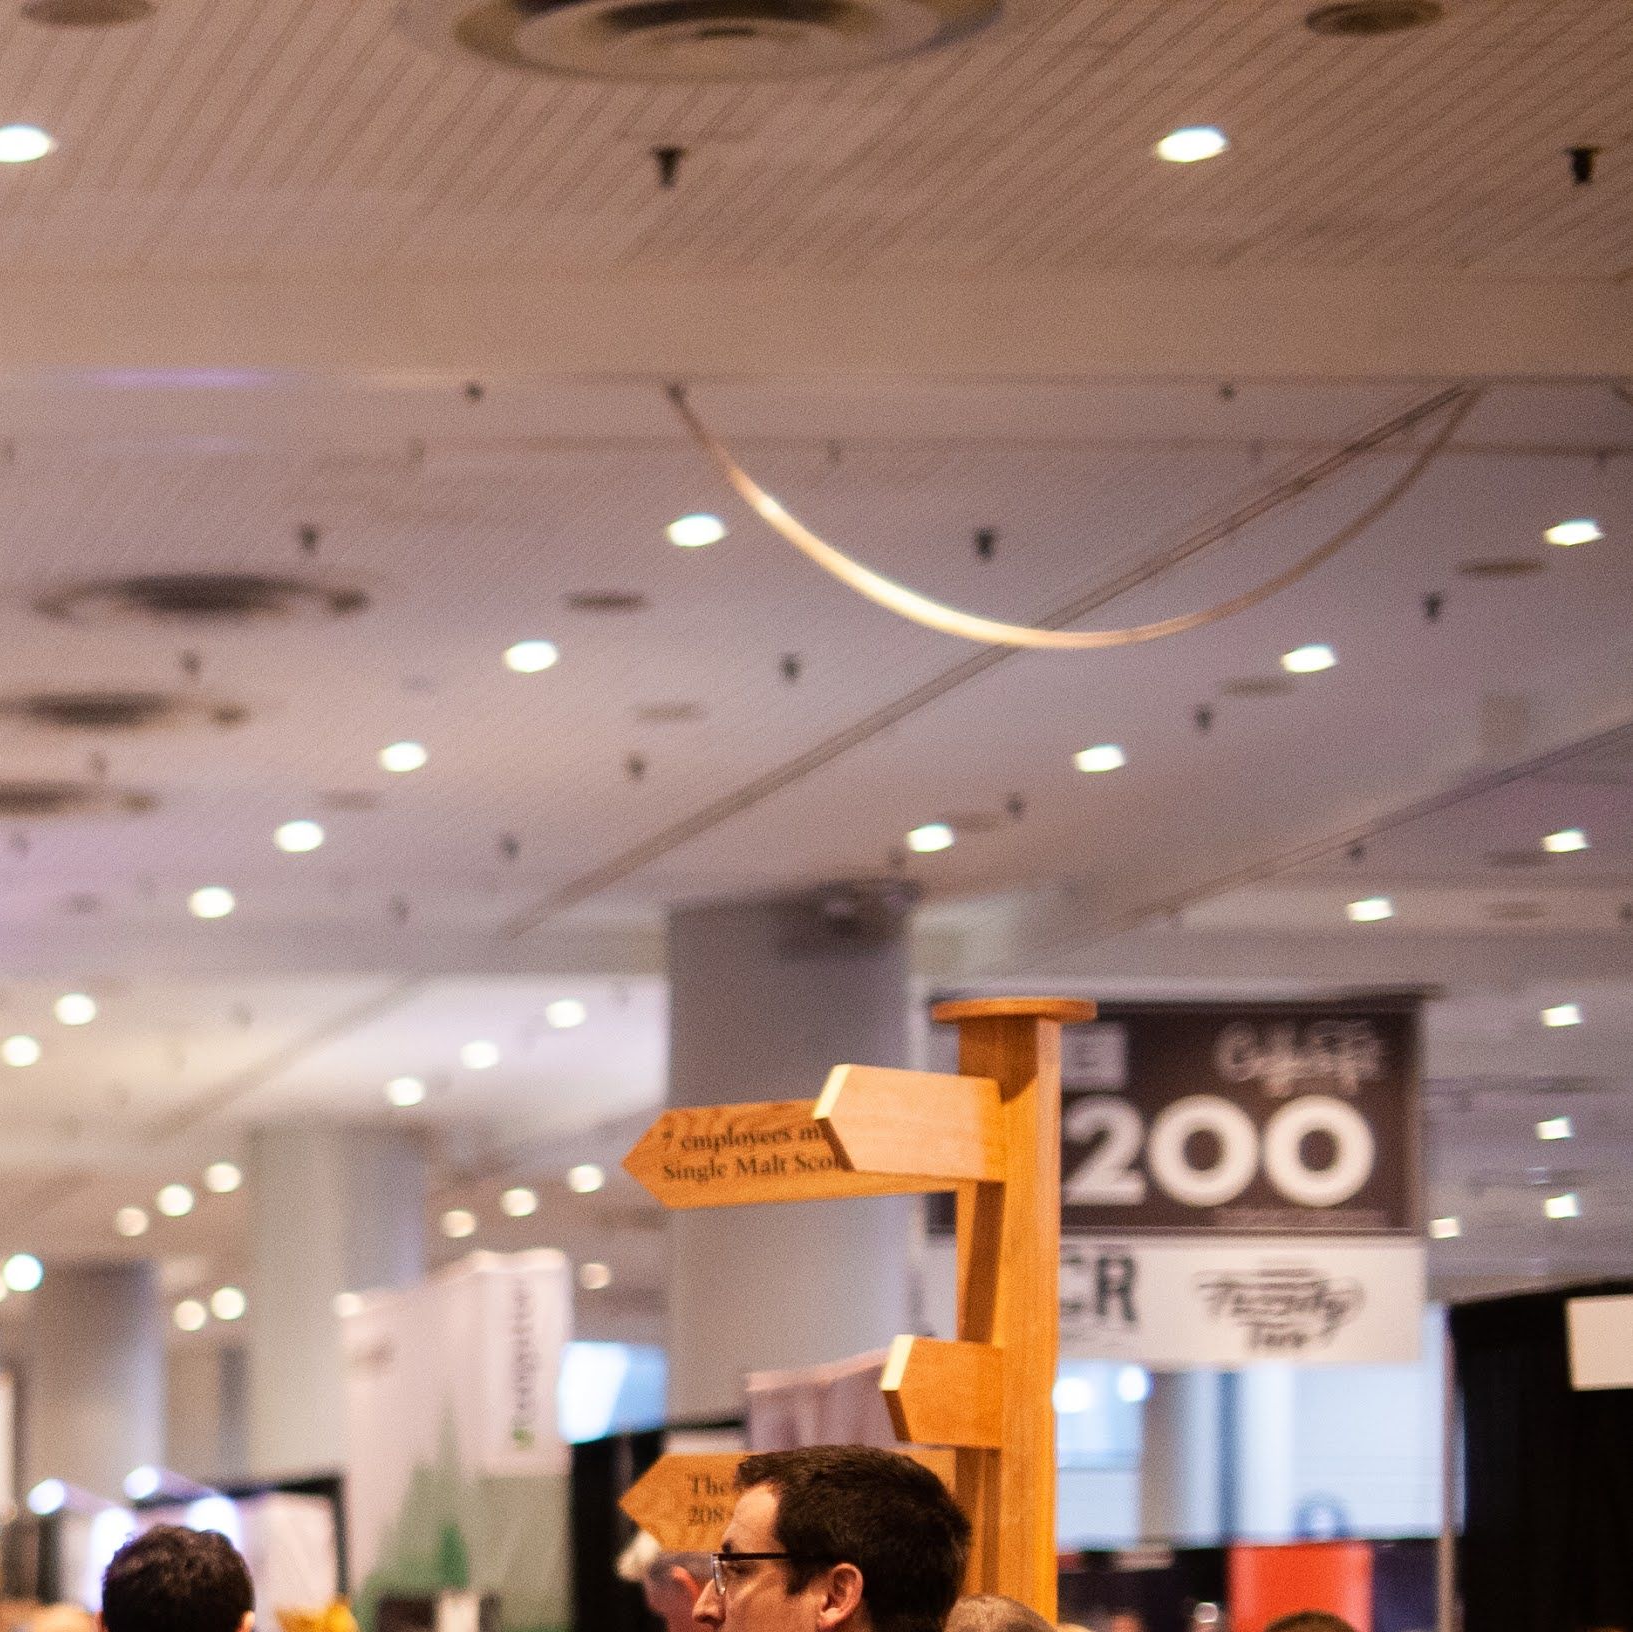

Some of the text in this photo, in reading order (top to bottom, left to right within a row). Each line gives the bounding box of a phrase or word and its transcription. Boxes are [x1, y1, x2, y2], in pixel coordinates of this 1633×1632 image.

[664, 1154, 727, 1183] Single
[736, 1154, 787, 1177] Malt
[1062, 1094, 1376, 1208] 200
